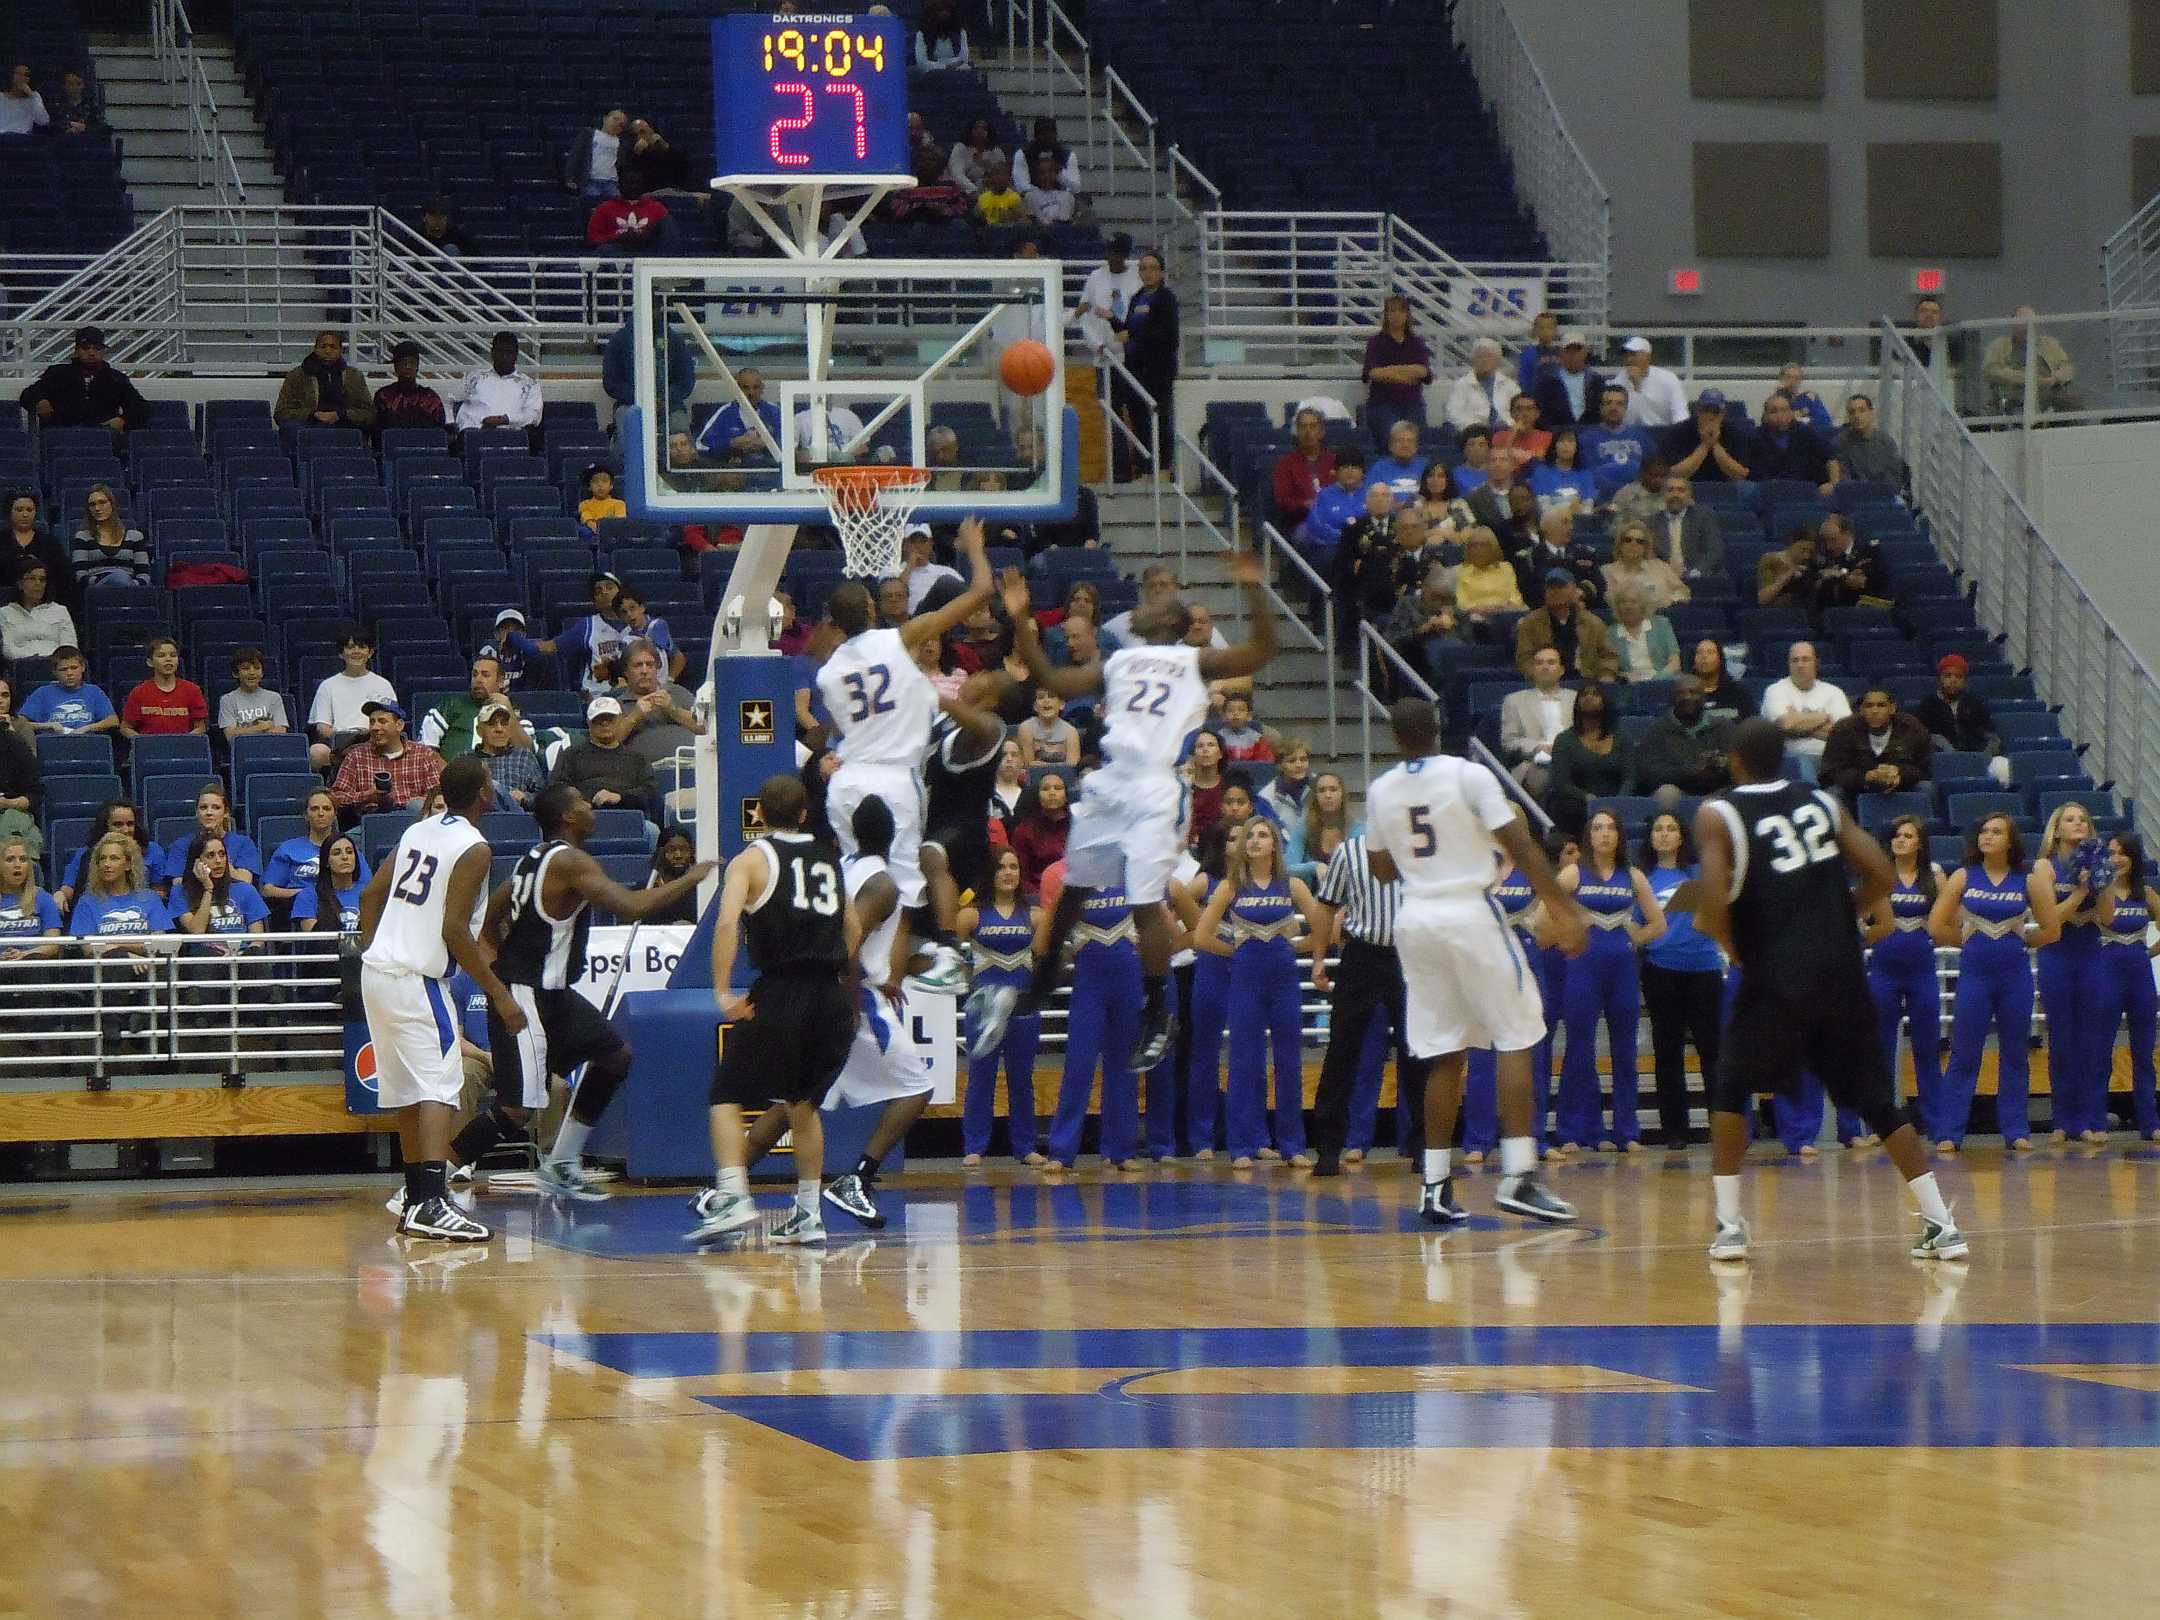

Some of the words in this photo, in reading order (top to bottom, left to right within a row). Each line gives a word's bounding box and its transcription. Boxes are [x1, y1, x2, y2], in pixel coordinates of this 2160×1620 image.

[773, 14, 853, 23] DAKTRONICS
[763, 29, 884, 76] 19:04
[770, 83, 866, 164] 27
[843, 664, 896, 722] 32
[1126, 680, 1170, 716] 22
[1409, 806, 1436, 857] 5
[1755, 803, 1840, 873] 32
[393, 849, 439, 905] 23
[791, 857, 838, 915] 13
[1235, 896, 1293, 907] HOFSTRA
[1964, 888, 2024, 901] HOFSTRA
[98, 921, 148, 933] HOFSTRA
